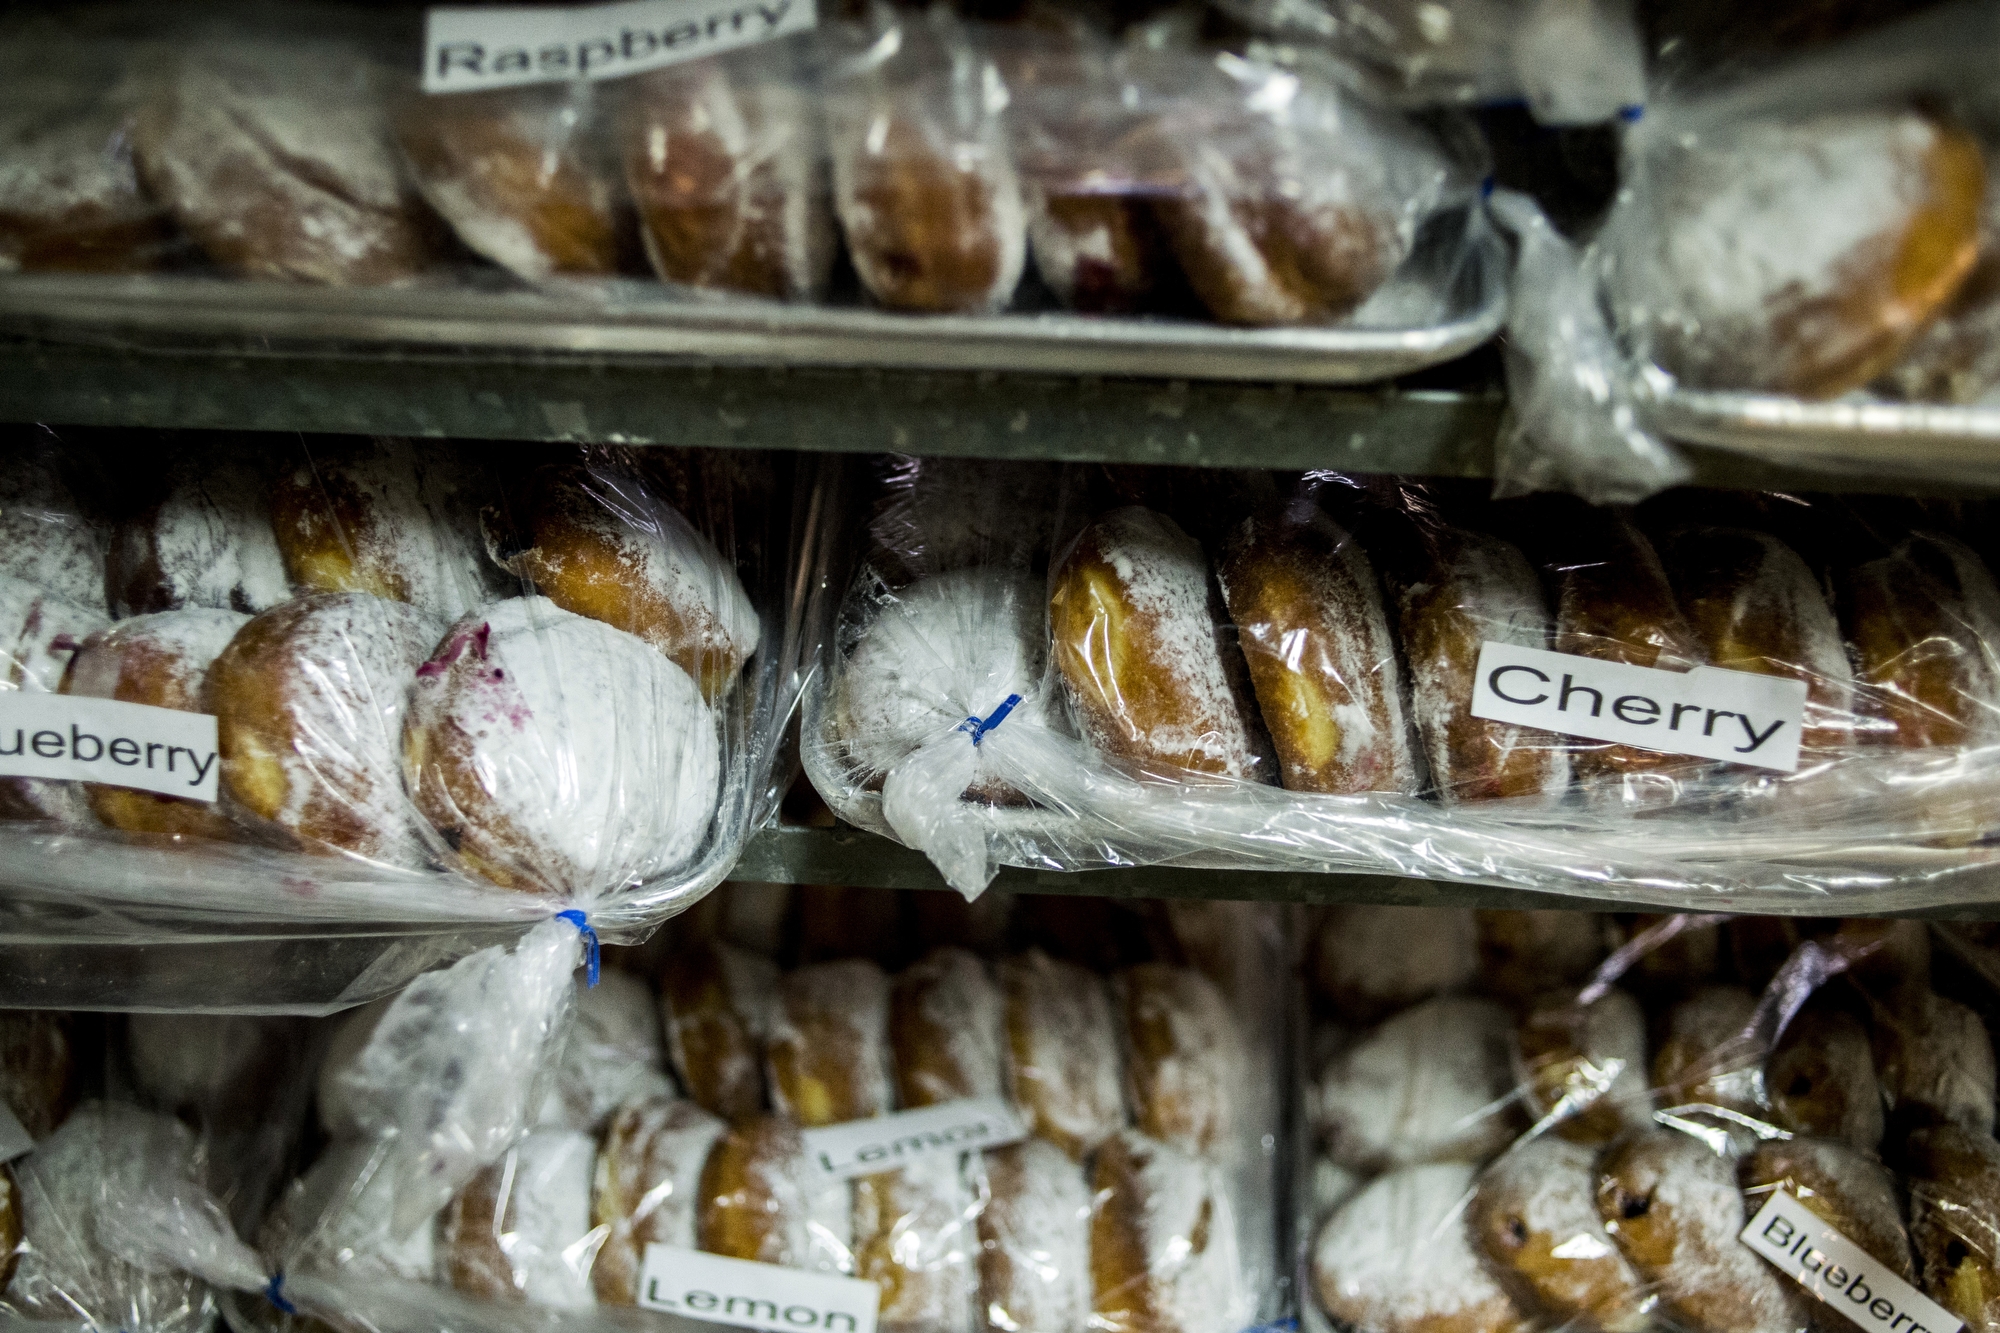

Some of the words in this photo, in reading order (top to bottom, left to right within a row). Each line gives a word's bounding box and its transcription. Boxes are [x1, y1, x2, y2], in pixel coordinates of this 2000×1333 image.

[437, 0, 792, 76] Raspberry
[1488, 665, 1786, 753] Cherry
[646, 1276, 857, 1333] Lemon
[1761, 1214, 1932, 1333] Blueberr
